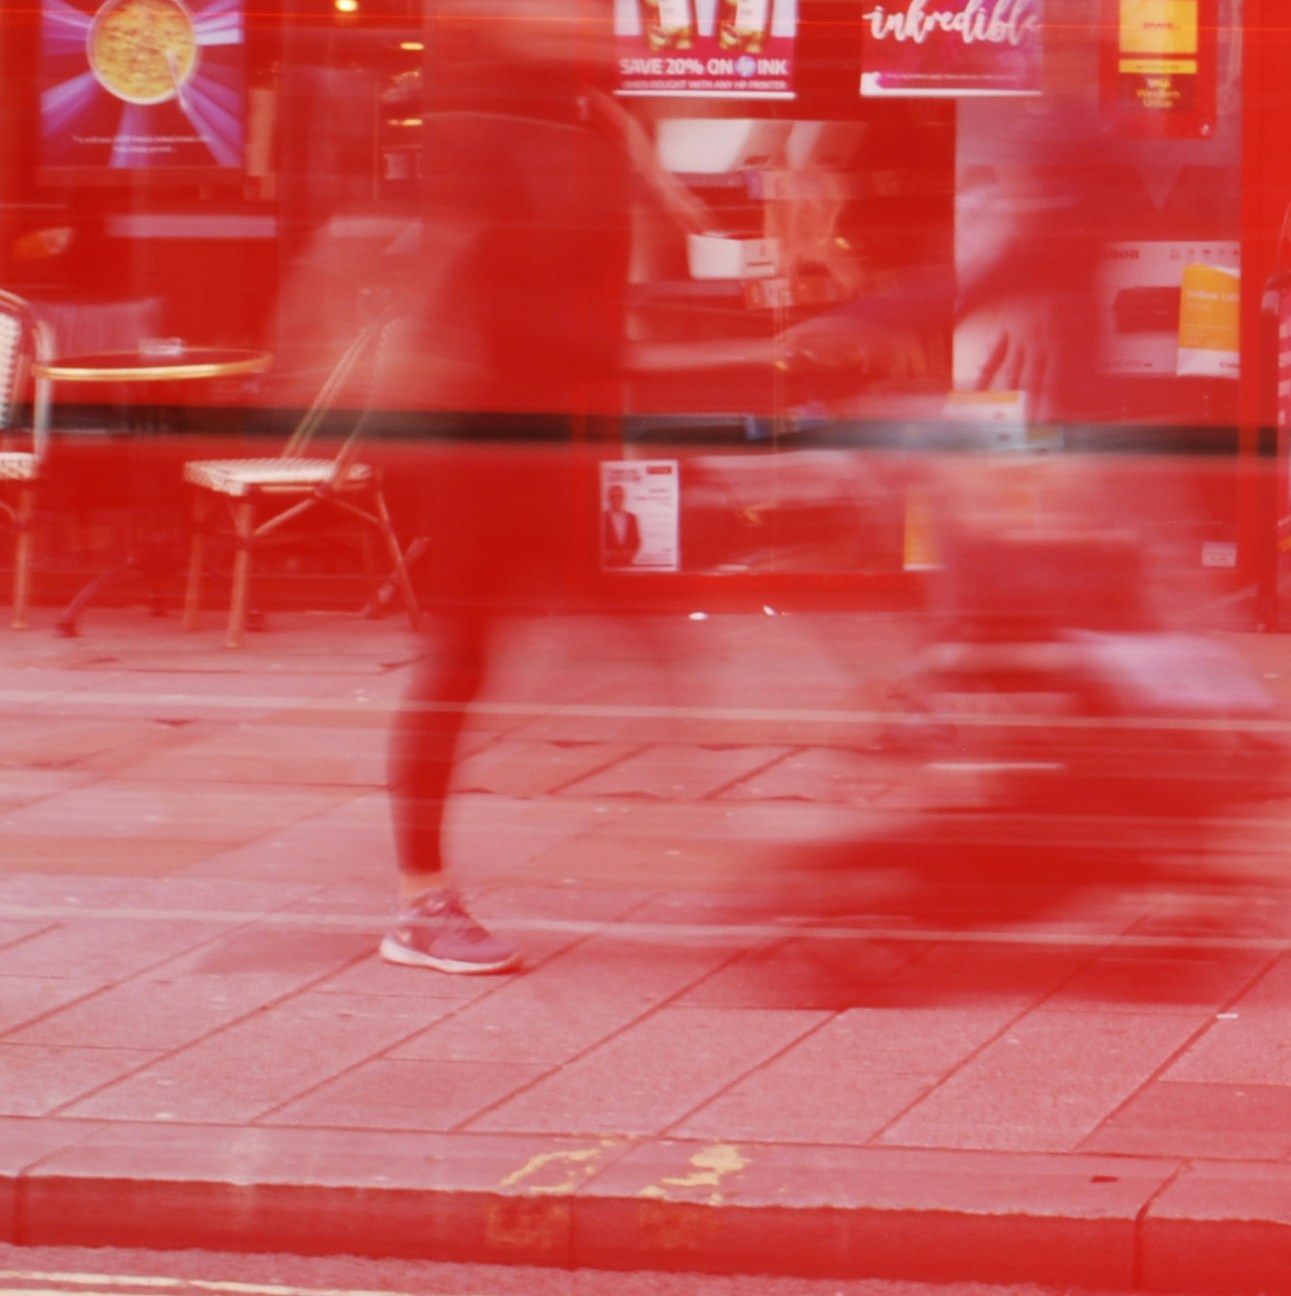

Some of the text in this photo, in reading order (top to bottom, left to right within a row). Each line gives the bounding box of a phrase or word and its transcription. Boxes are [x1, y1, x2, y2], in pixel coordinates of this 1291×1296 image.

[619, 57, 662, 74] SAVE
[664, 58, 703, 74] 20%
[706, 58, 733, 75] ON
[758, 59, 788, 76] INK
